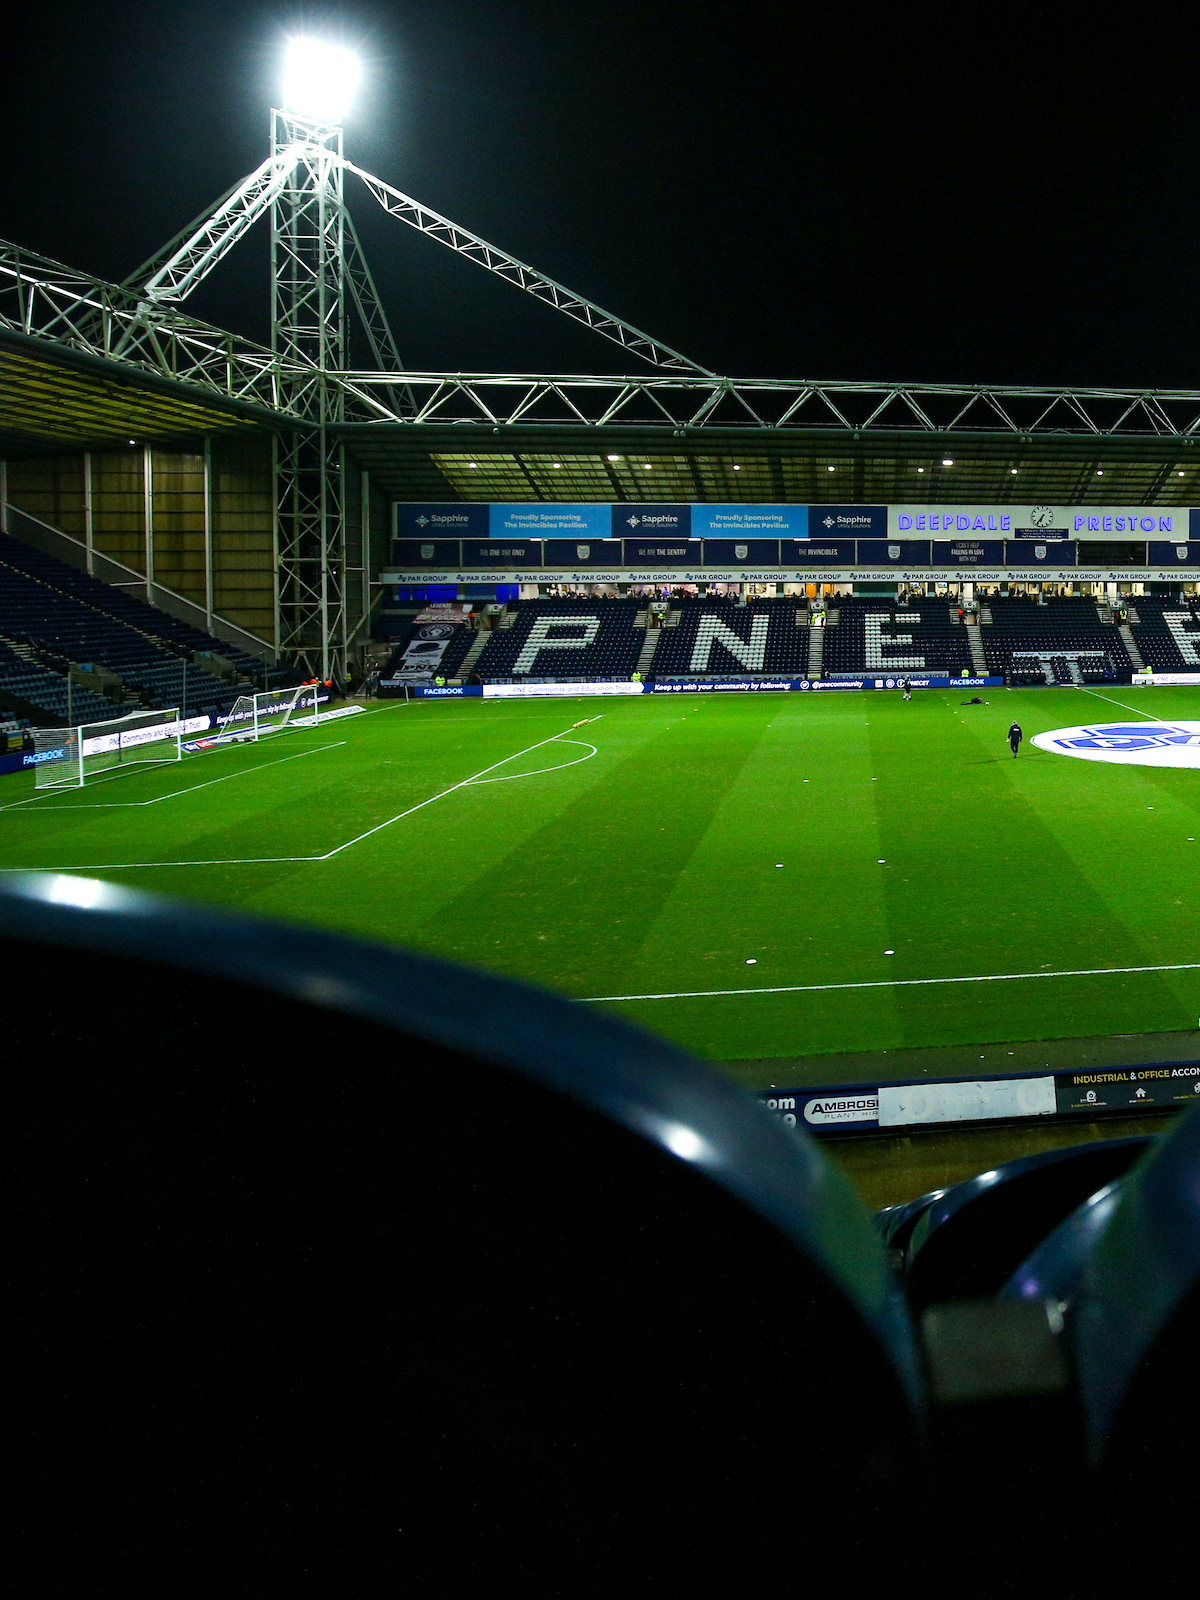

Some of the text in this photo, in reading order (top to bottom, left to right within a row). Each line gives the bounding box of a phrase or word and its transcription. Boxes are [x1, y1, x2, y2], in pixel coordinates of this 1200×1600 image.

[430, 514, 469, 524] Sapphire
[642, 515, 678, 524] Sapphire
[837, 516, 872, 525] Sapphire
[899, 514, 1011, 530] DEEPDALE
[1074, 515, 1173, 531] PRESTON
[512, 615, 600, 674] P
[690, 615, 769, 671] N
[865, 613, 925, 668] E
[812, 680, 863, 688] @pnecommunity
[122, 731, 152, 744] Community
[153, 729, 163, 737] and
[164, 724, 188, 736] Educaion
[189, 720, 201, 730] Trust
[23, 749, 64, 765] FACEBOOK
[1074, 1073, 1128, 1084] INDUSTRIAL
[1130, 1072, 1136, 1080] &
[1138, 1070, 1170, 1080] OFFICE
